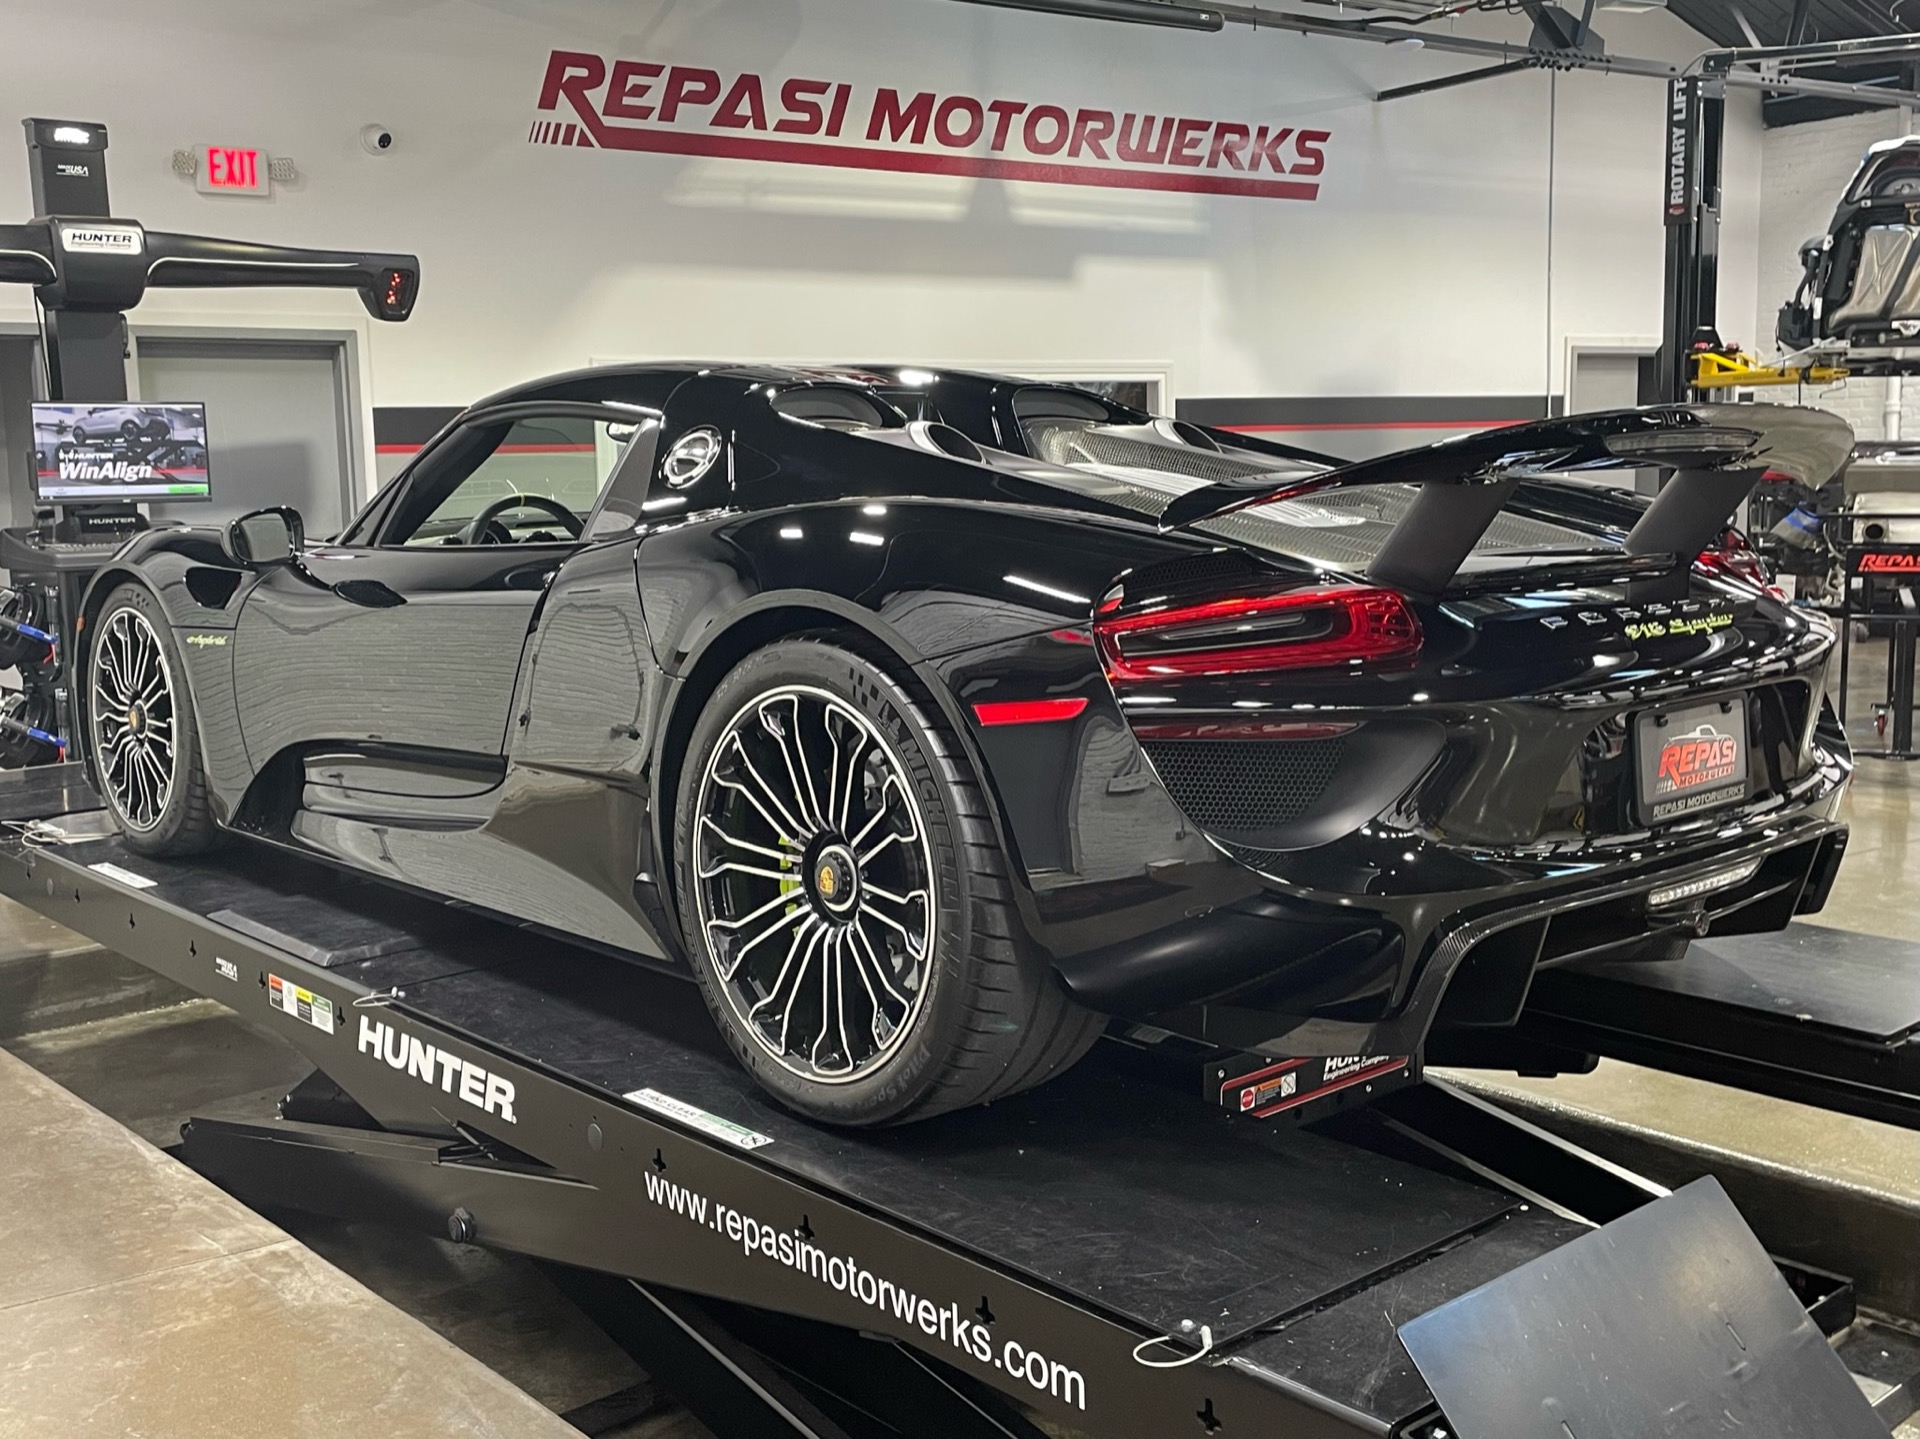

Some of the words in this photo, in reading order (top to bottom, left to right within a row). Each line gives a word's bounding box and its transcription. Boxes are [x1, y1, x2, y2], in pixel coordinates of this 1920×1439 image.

[537, 50, 853, 148] REPASI
[865, 88, 1332, 176] MOTORWERKS
[1672, 79, 1688, 122] LIFT
[208, 147, 257, 187] EXIT
[1669, 127, 1687, 206] ROTARY
[72, 233, 132, 243] HUNTER
[59, 461, 151, 482] WinAlign
[75, 452, 114, 460] HUNTER
[88, 516, 136, 525] HUNTER
[1657, 738, 1736, 788] REPASI
[1653, 801, 1687, 818] REPASI
[1687, 784, 1746, 808] MOTORWERKS
[900, 738, 961, 912] MICHELIN
[358, 1014, 517, 1124] HUNTER
[1323, 1063, 1361, 1081] Engineering
[644, 1171, 1087, 1411] www.repasimotorwerks.com
